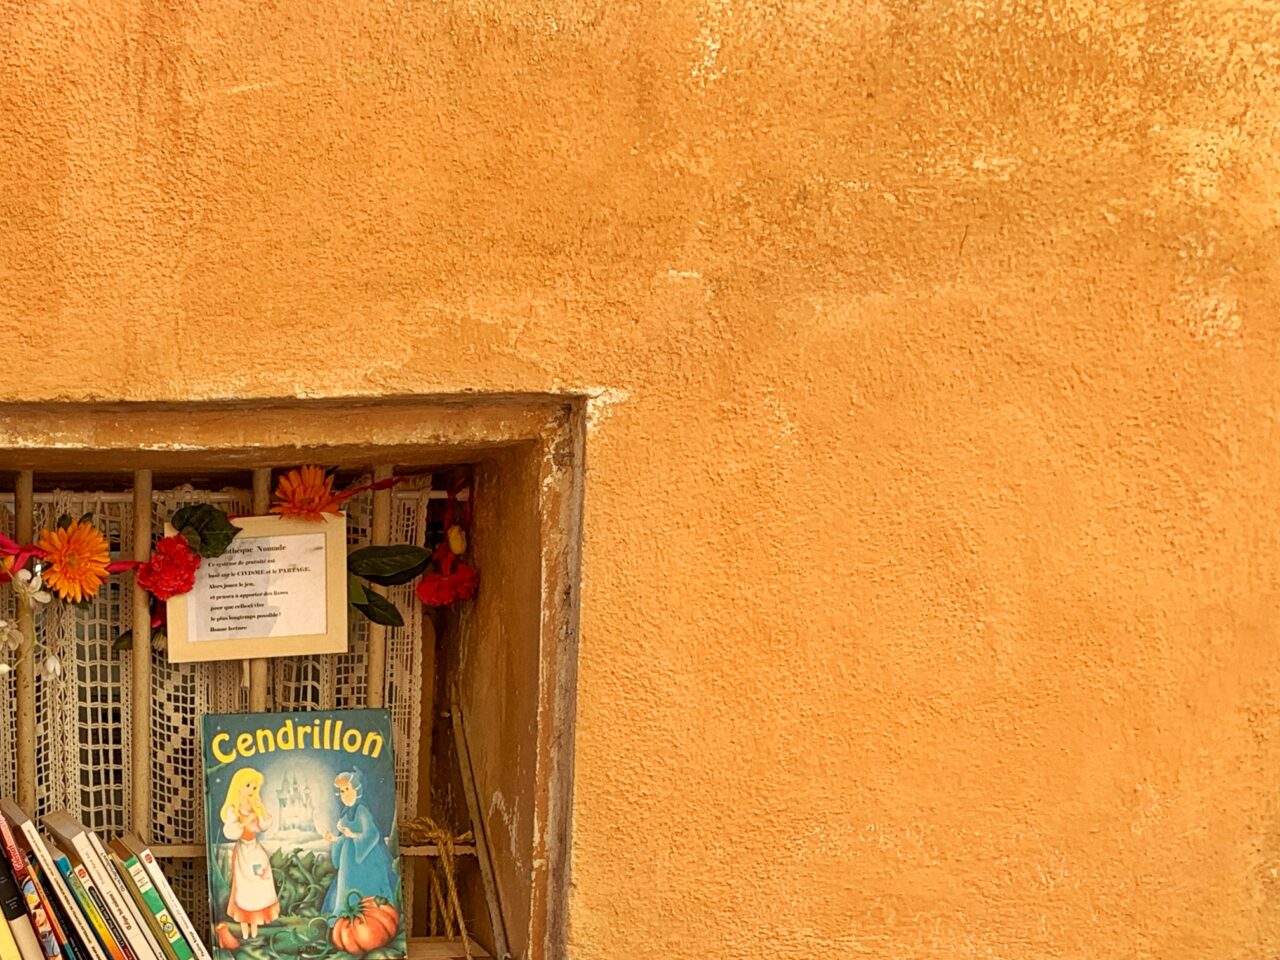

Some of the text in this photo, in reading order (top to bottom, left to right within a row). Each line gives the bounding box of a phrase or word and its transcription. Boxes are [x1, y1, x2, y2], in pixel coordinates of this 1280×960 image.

[256, 544, 286, 552] Nomade
[256, 612, 278, 620] possible
[211, 718, 384, 764] Cendrillon
[195, 942, 205, 957] Pauline
